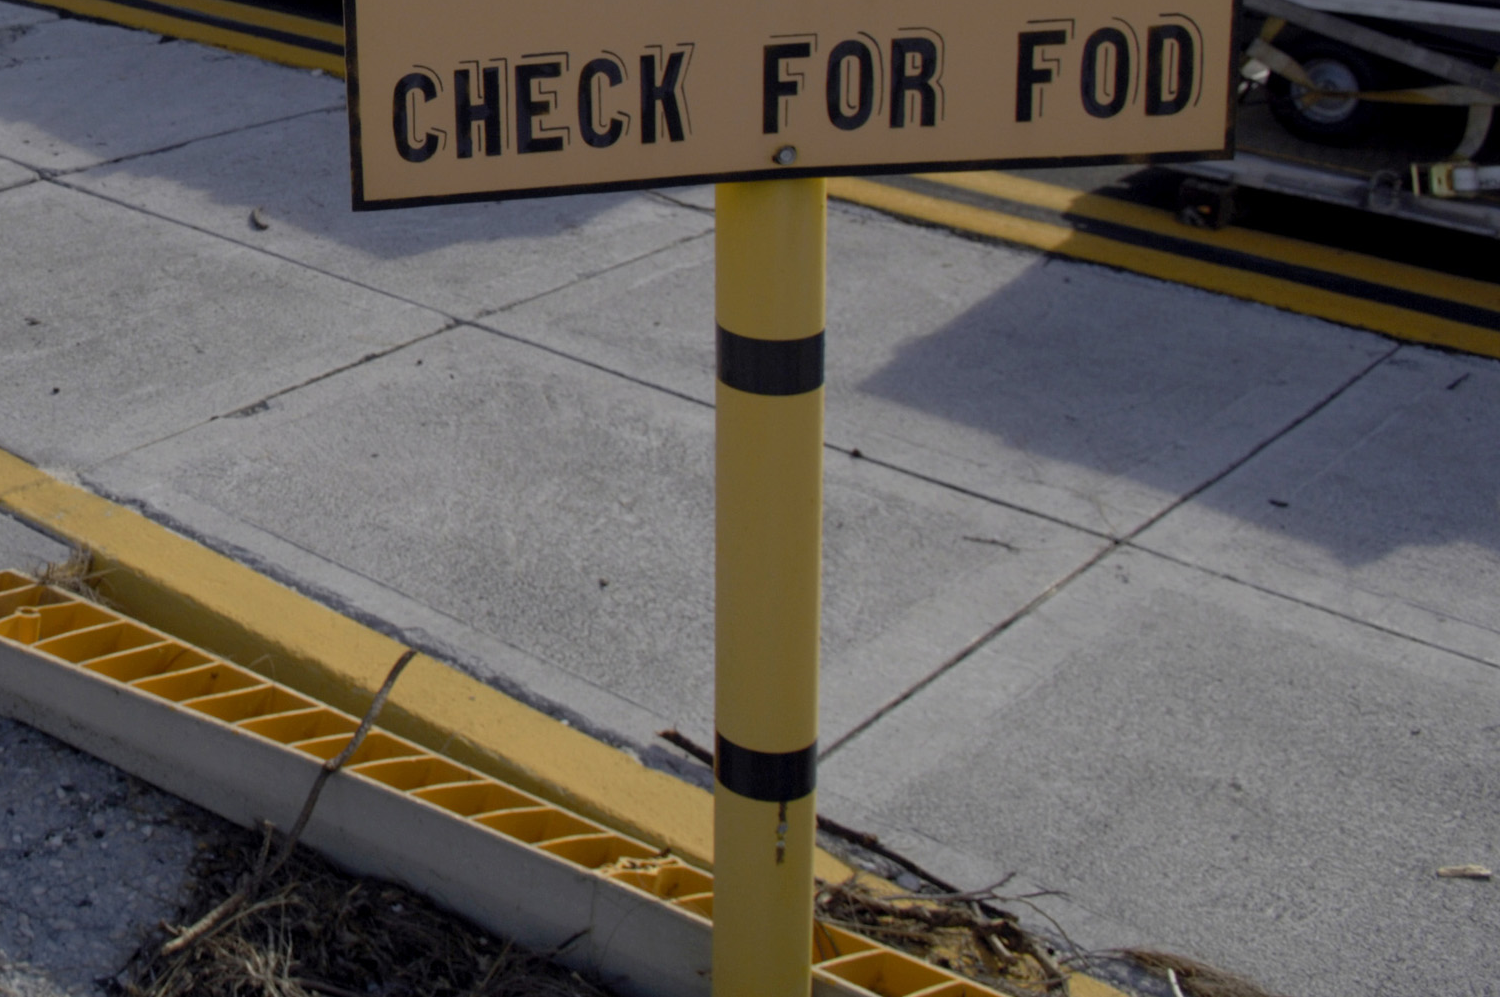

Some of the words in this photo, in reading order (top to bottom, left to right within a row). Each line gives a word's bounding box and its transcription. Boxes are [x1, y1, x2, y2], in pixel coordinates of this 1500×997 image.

[391, 42, 696, 163] CHECK
[761, 27, 946, 136] FOR
[1014, 12, 1205, 124] FOD
